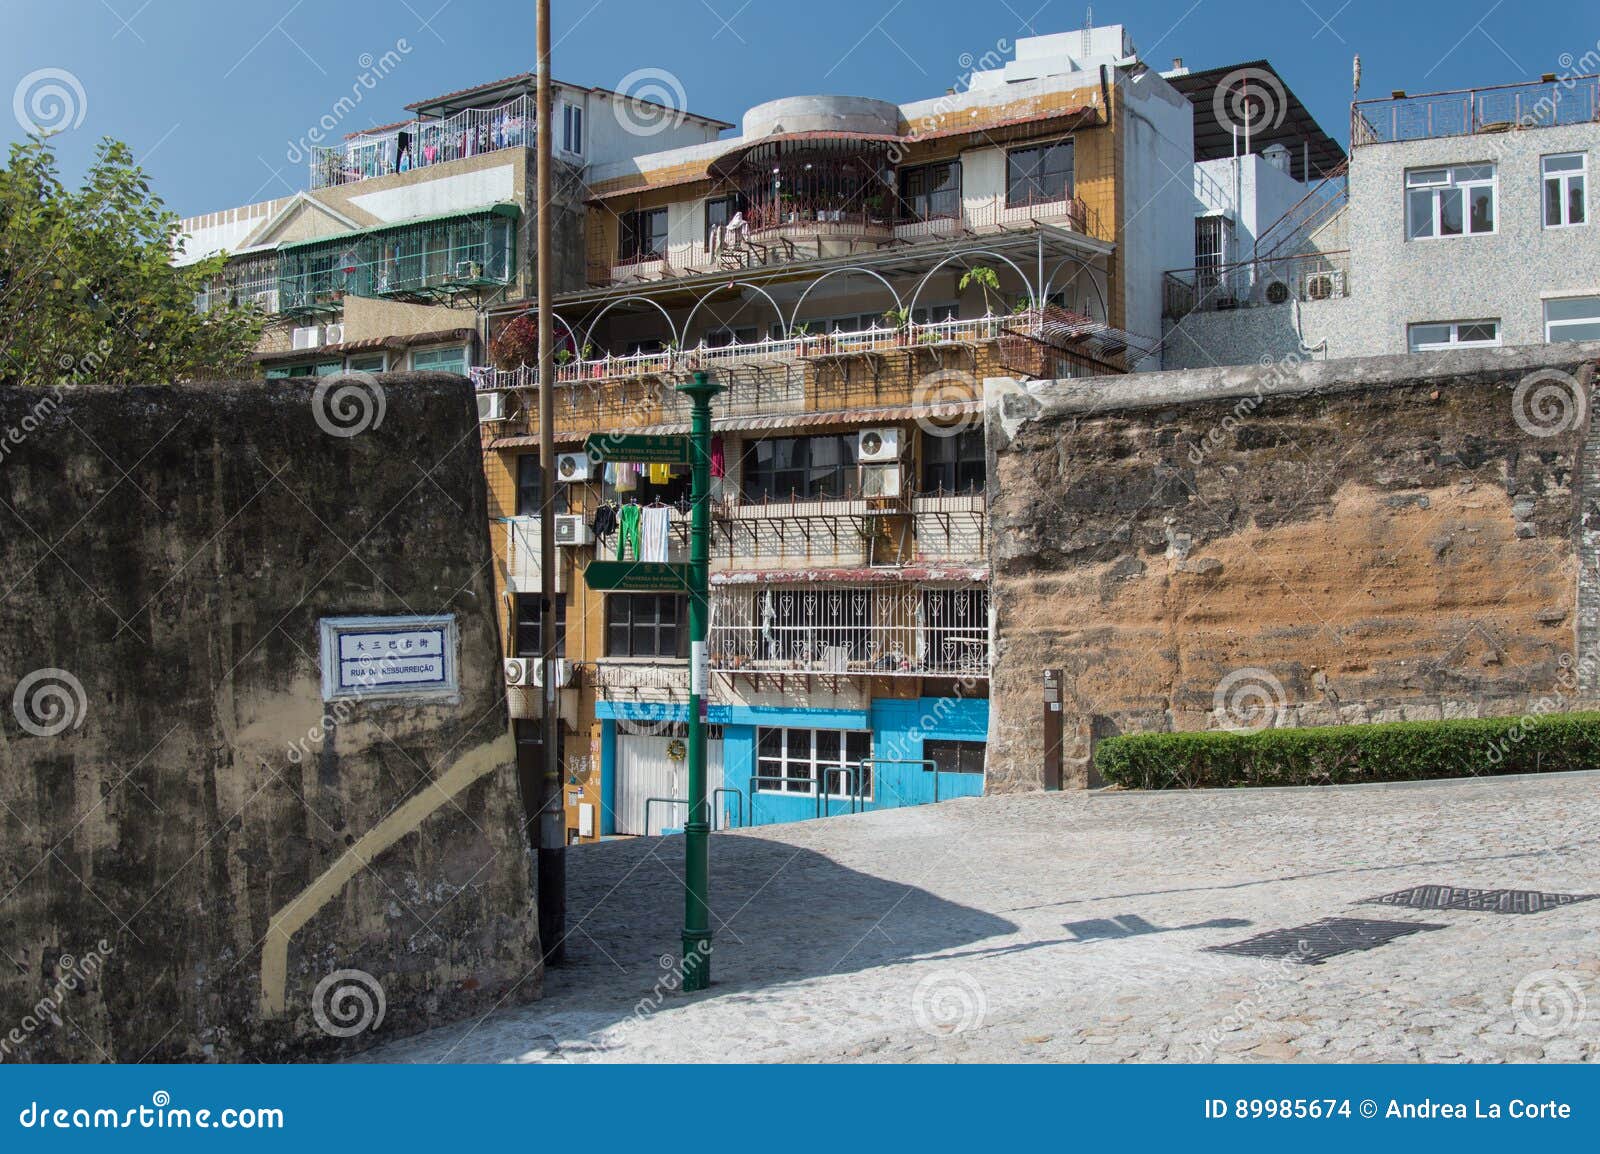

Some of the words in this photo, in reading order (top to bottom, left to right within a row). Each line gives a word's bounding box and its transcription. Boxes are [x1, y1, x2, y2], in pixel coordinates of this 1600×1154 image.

[357, 639, 429, 650] 大三巴右街
[351, 668, 365, 676] RUA
